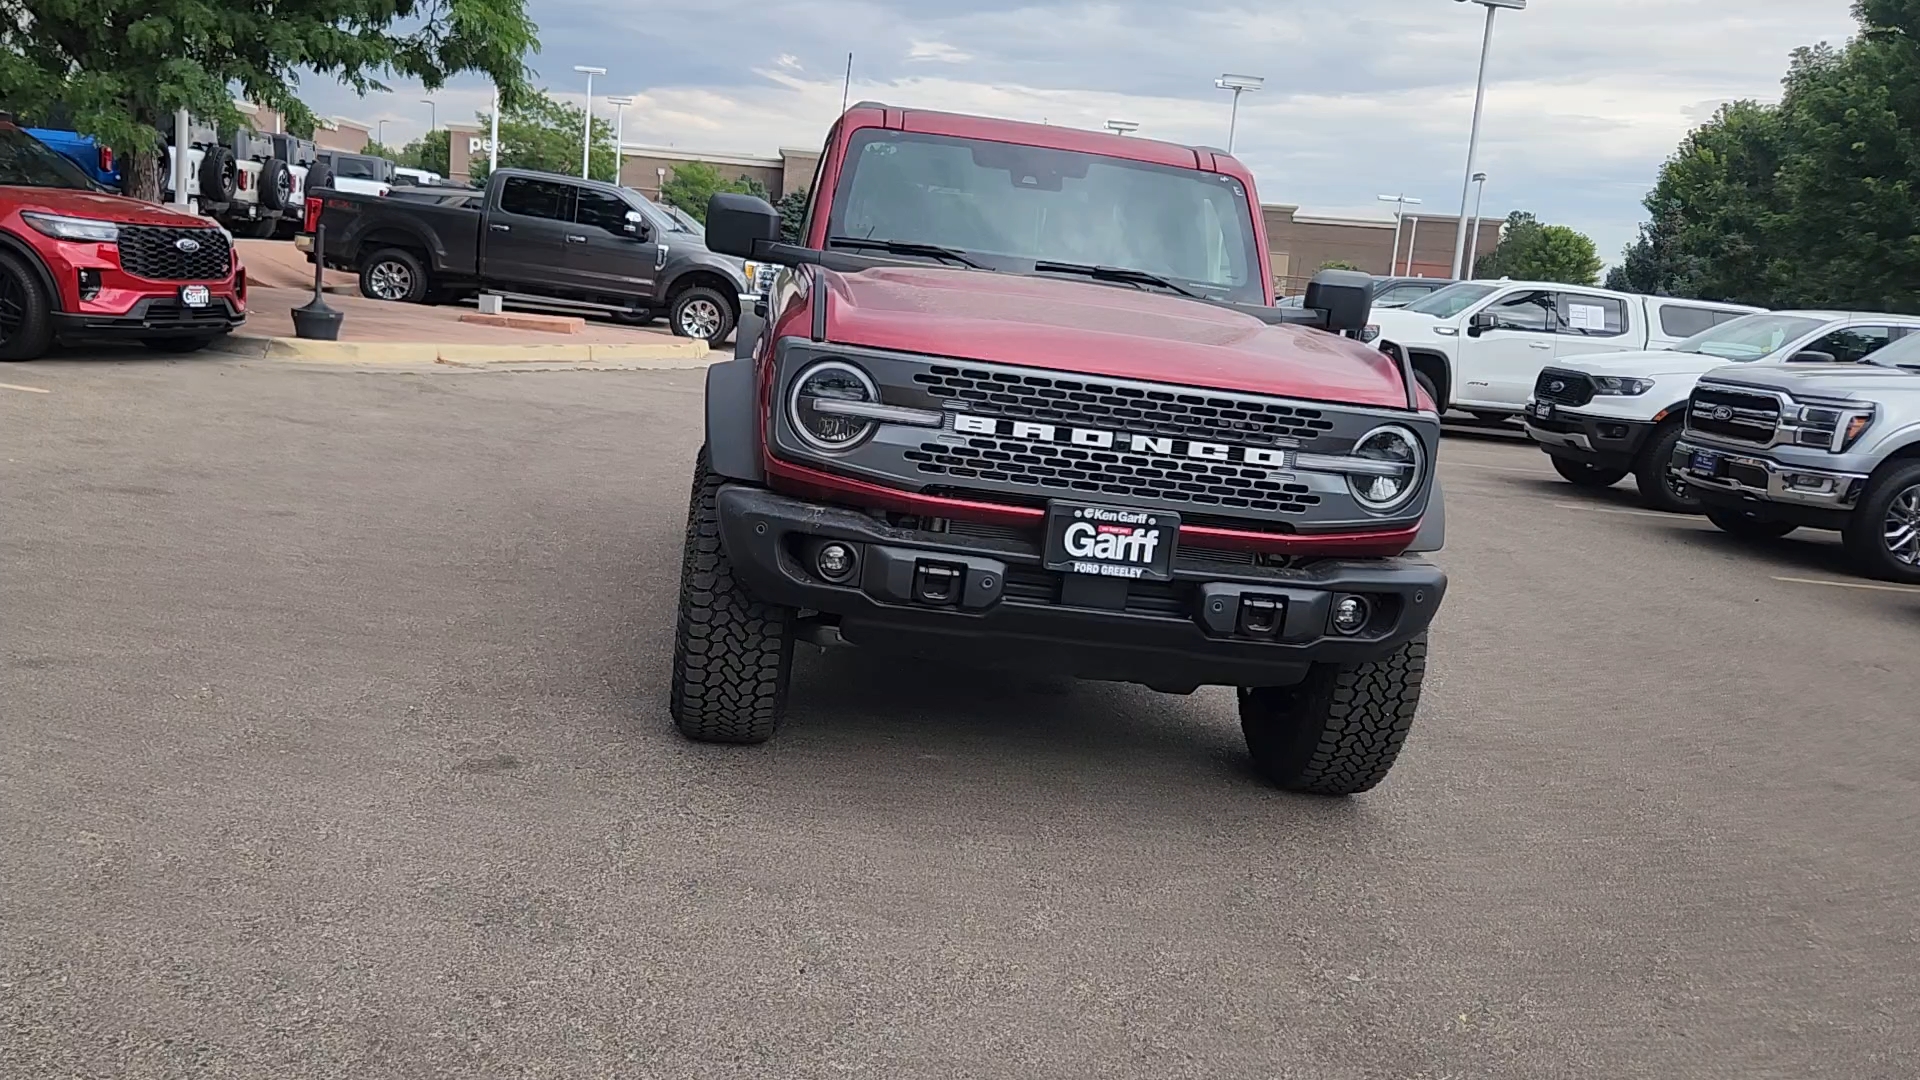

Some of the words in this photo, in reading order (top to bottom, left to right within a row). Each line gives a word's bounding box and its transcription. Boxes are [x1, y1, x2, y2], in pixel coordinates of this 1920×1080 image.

[954, 414, 1285, 467] BRONCO
[1094, 508, 1117, 522] Ken
[1118, 511, 1148, 524] Garff
[1064, 521, 1160, 563] Garff
[1074, 562, 1100, 574] FORD
[1100, 565, 1143, 578] GREELEY
